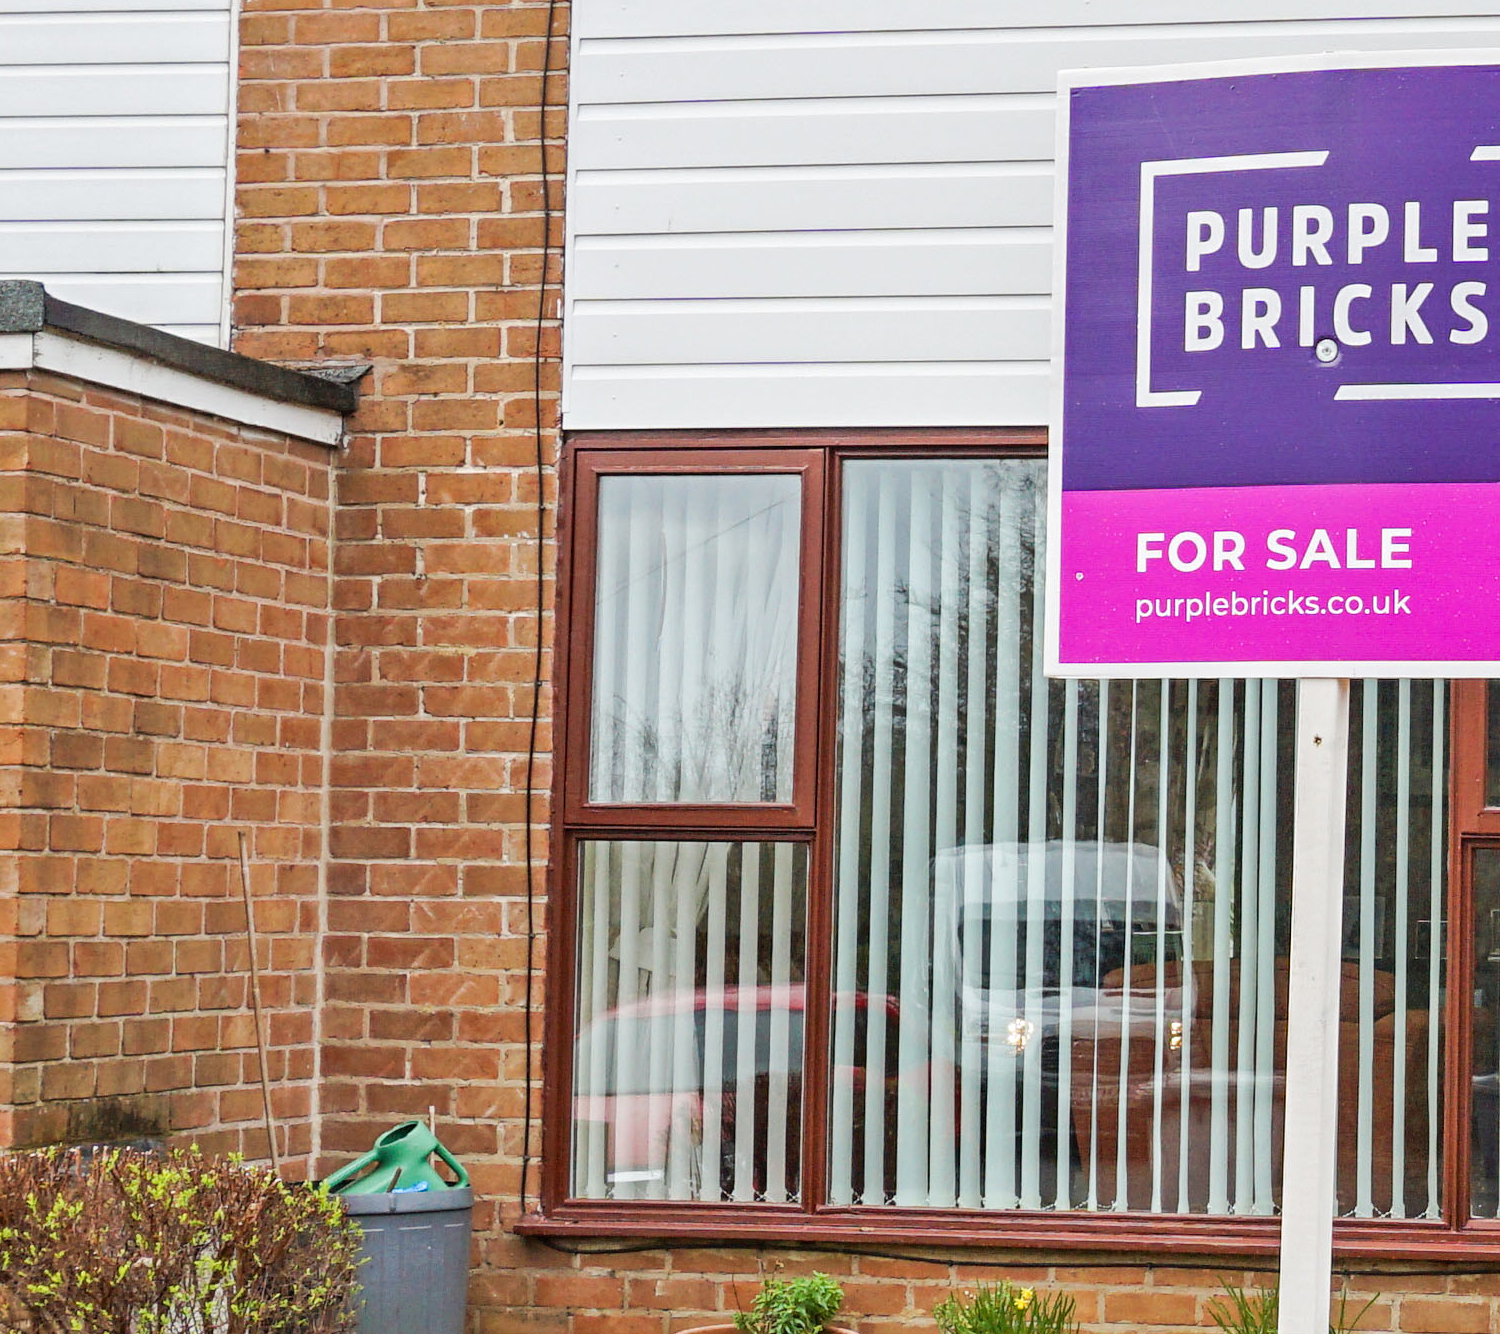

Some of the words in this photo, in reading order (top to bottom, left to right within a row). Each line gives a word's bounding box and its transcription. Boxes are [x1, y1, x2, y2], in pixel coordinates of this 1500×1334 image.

[1186, 200, 1489, 271] PURPLE
[1184, 281, 1489, 352] BRICKS
[1136, 531, 1245, 573] FOR
[1266, 528, 1412, 570] SALE
[1135, 589, 1411, 624] purplebricks.co.uk
